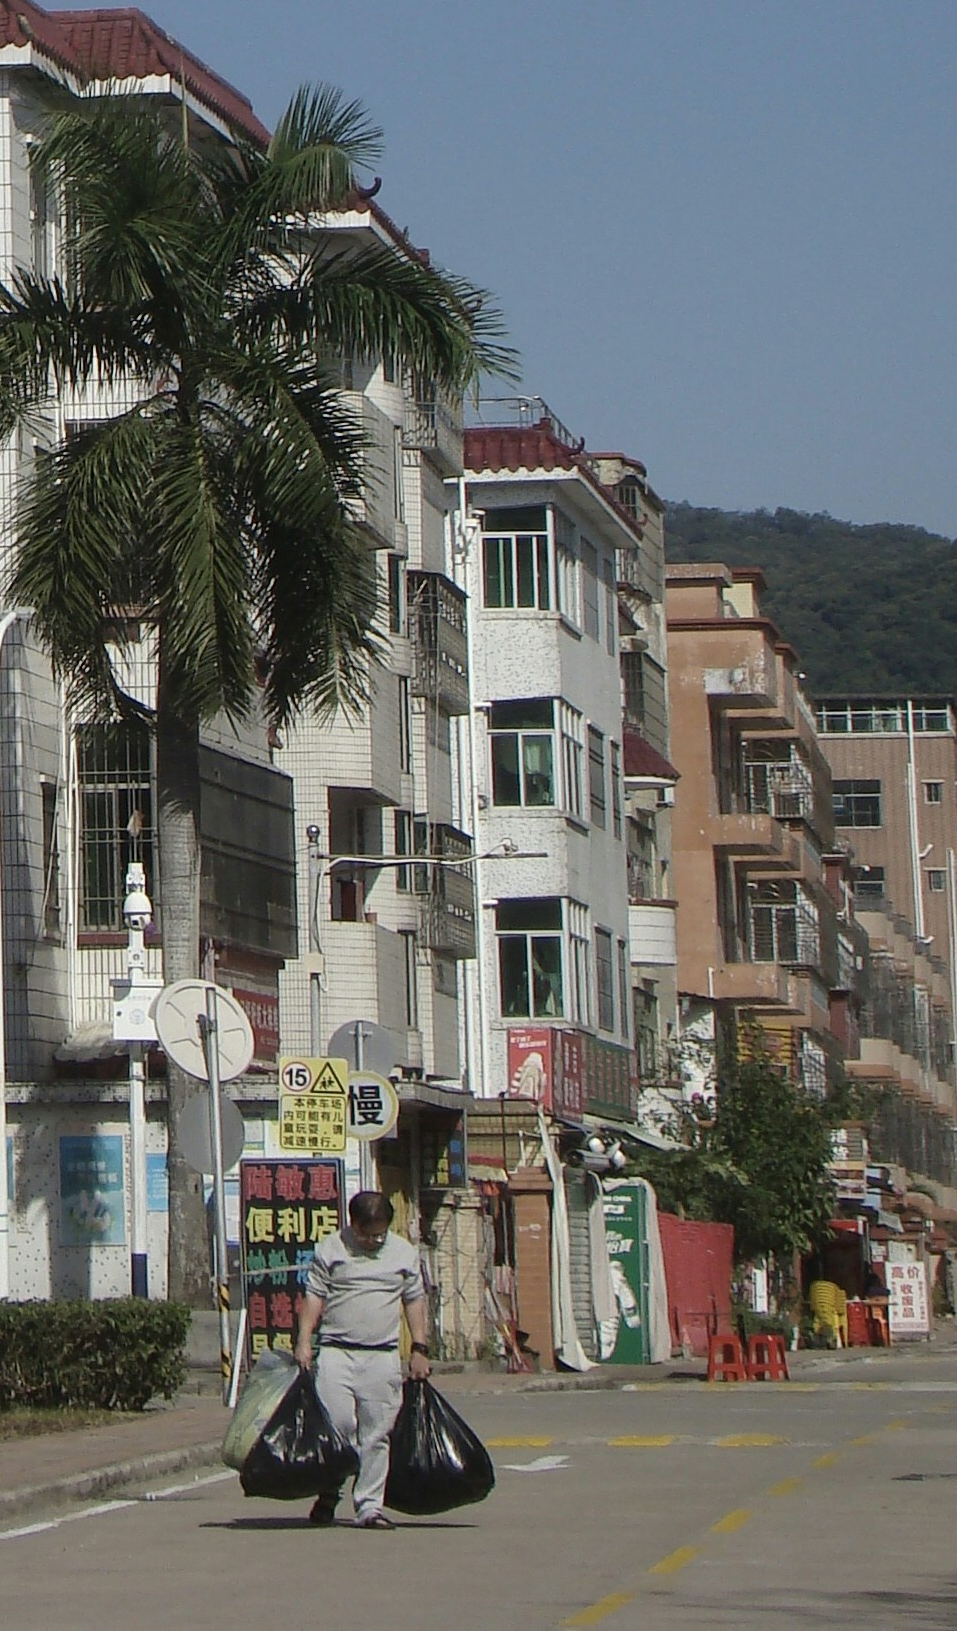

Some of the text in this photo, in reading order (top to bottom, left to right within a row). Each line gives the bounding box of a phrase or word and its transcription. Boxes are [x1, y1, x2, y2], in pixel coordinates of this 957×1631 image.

[285, 1068, 308, 1087] 15
[283, 1111, 343, 1122] 内可能有儿
[294, 1098, 342, 1109] 本停车场
[348, 1085, 384, 1126] 慢
[244, 1164, 338, 1201] 陆敏惠
[245, 1206, 338, 1244] 便利店
[891, 1265, 920, 1279] 高价
[900, 1283, 914, 1318] 收废品
